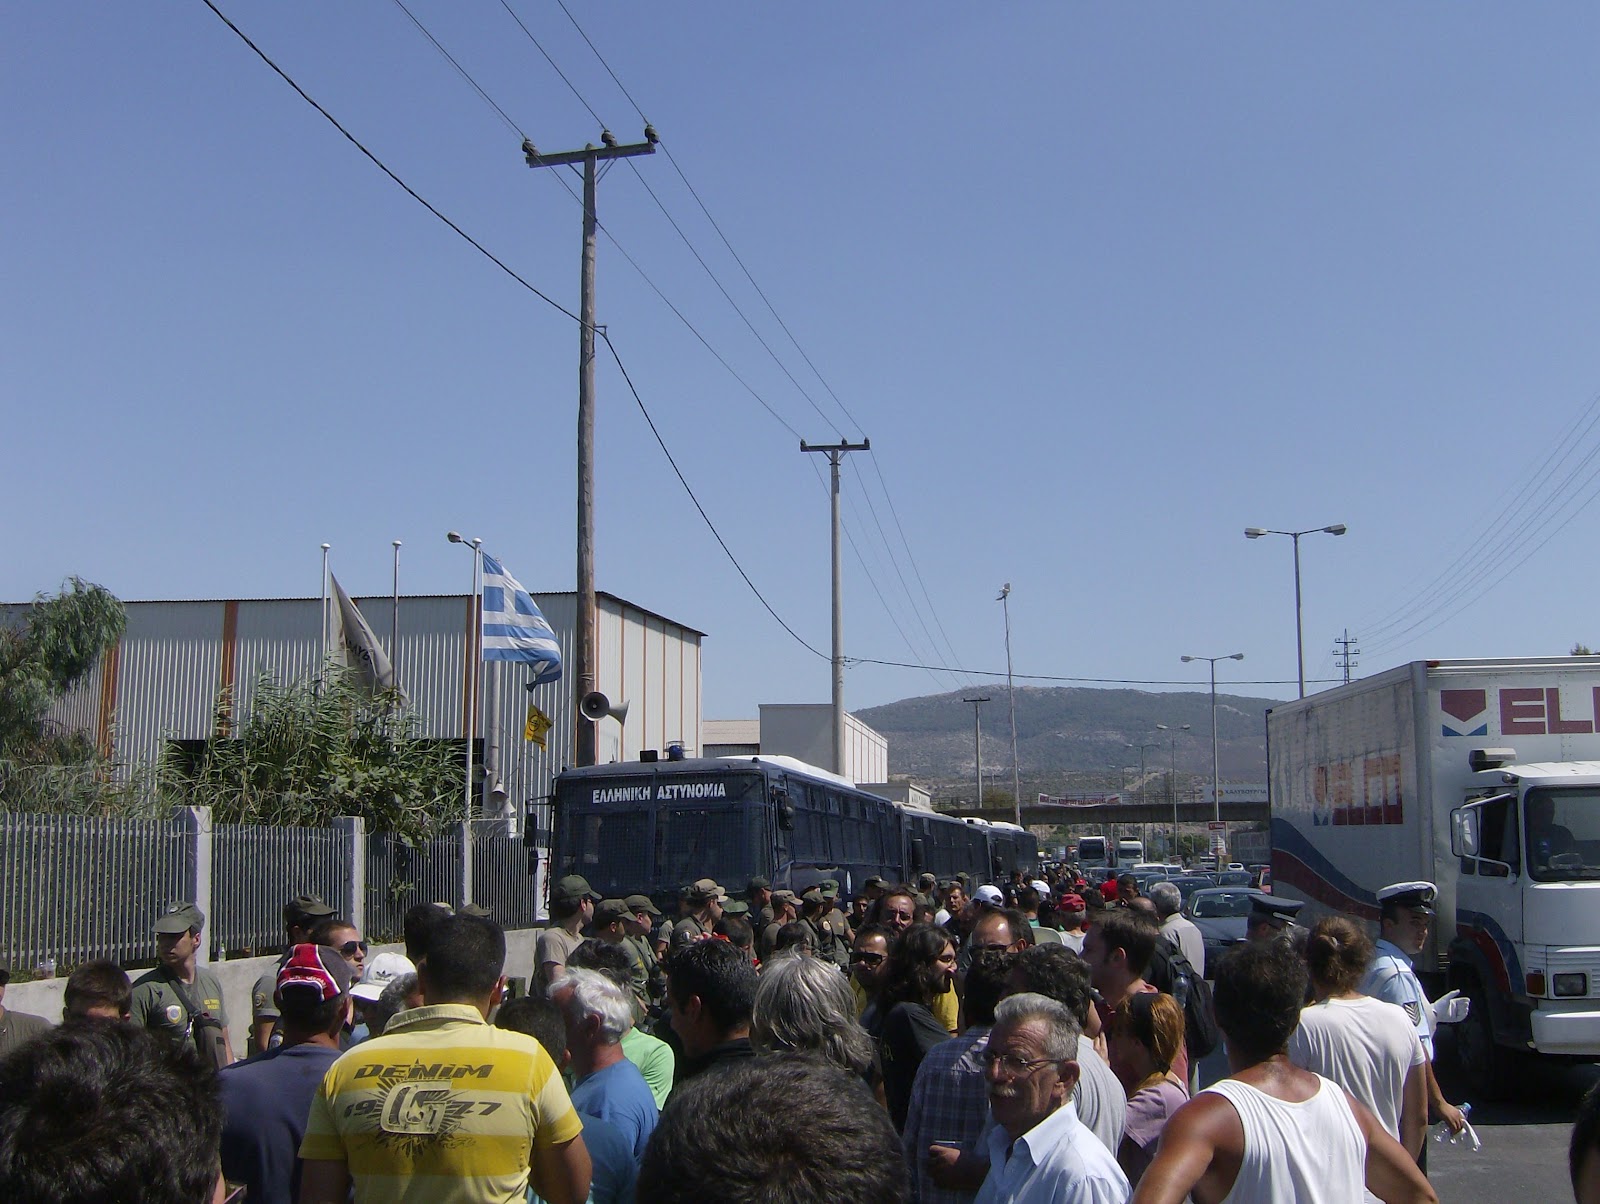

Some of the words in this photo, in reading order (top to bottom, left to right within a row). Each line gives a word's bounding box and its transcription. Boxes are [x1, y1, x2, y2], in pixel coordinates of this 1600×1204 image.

[1499, 687, 1600, 735] EL
[592, 786, 651, 804] ΕΛΛΗΝΙΚΗ
[657, 783, 726, 800] ΑΣΤΥΝΟΜΙΑ
